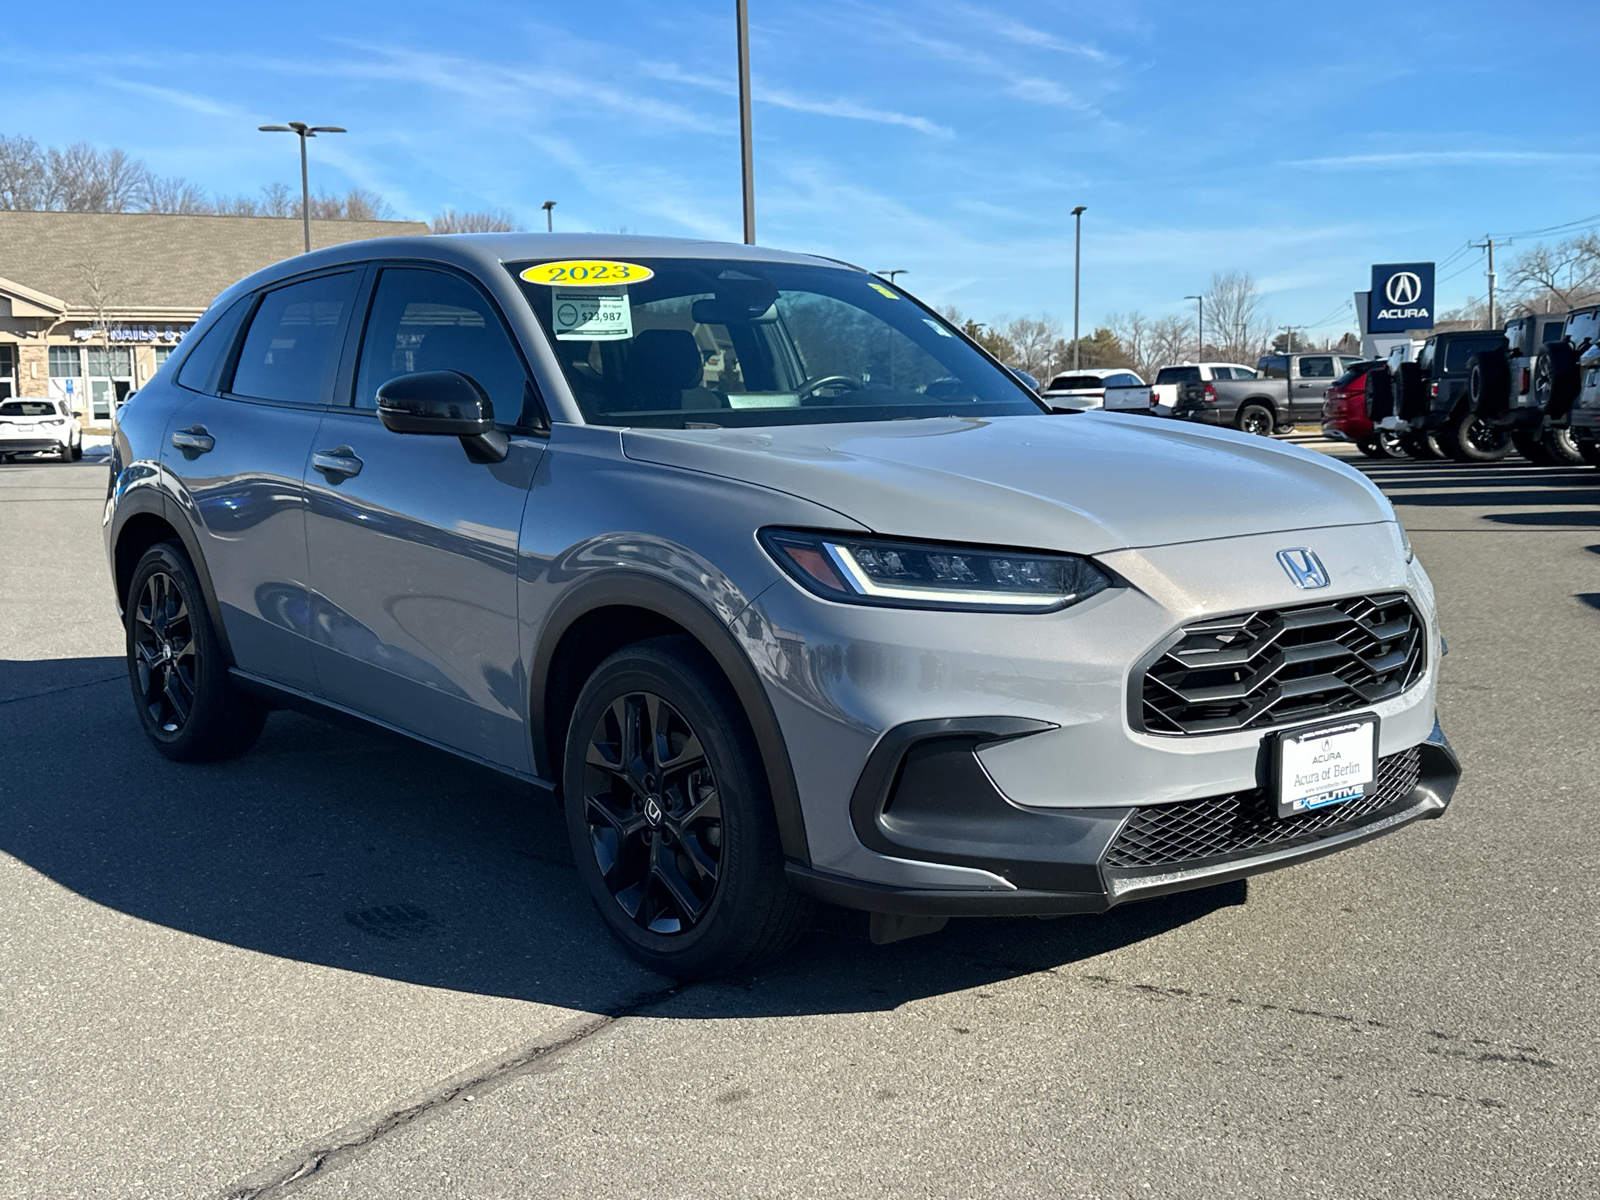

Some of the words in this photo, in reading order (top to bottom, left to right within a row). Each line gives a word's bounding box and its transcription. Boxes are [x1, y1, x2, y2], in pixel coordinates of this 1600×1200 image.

[548, 265, 630, 282] 2023
[581, 312, 622, 323] $23,987
[1377, 308, 1429, 320] ACURA
[110, 324, 158, 341] NAILS
[1311, 751, 1342, 765] ACURA
[1293, 772, 1319, 788] Acura
[1321, 767, 1331, 780] of
[1333, 761, 1360, 778] Berlin
[1292, 784, 1364, 810] EXECUTIVE
